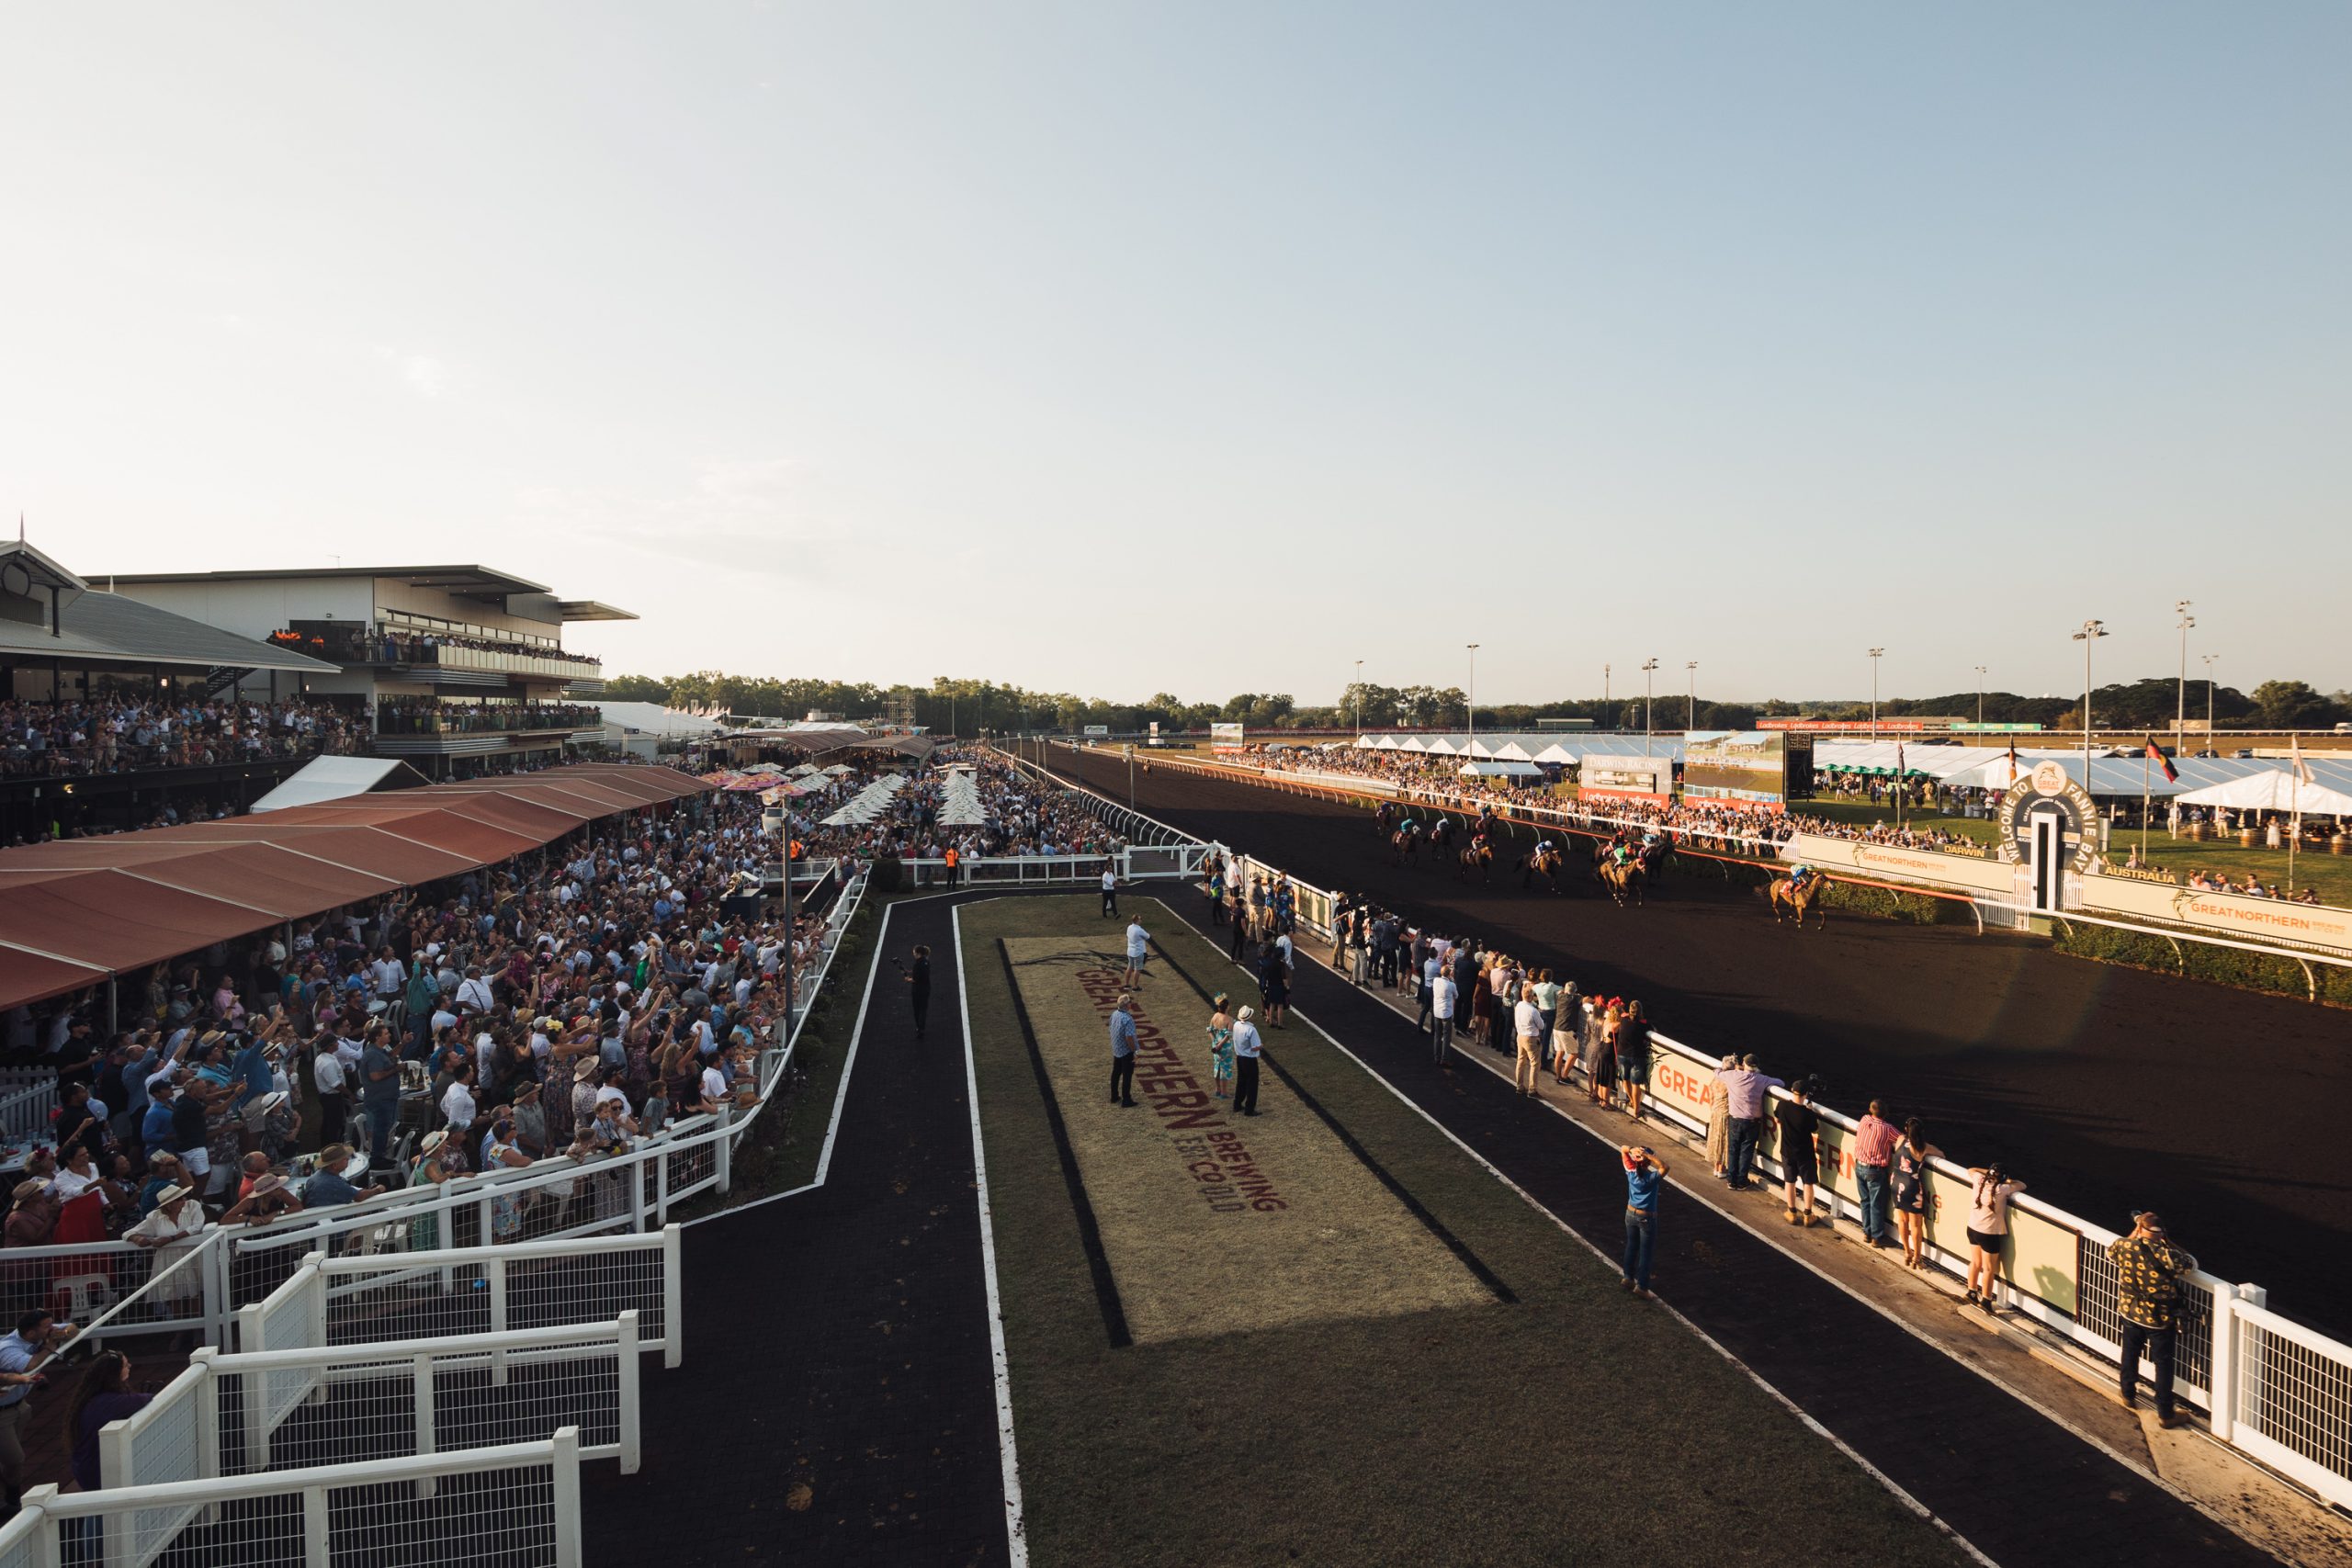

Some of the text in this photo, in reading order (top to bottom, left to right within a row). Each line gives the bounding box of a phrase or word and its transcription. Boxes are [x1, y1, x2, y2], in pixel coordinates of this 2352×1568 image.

[1589, 758, 1662, 771] DARWIN RACING
[2001, 781, 2097, 872] WELCOME TO FANNIE BAY
[1863, 852, 1887, 863] GREAT
[1887, 856, 1928, 870] NORTHERN
[1944, 845, 1985, 858] DARWIN
[2104, 866, 2177, 885] AUSTRALIA
[2191, 903, 2310, 930] GREAT NORTHERN
[1658, 1065, 1713, 1107] GREA
[1188, 1161, 1227, 1182] CO
[1206, 1132, 1289, 1212] BREWING
